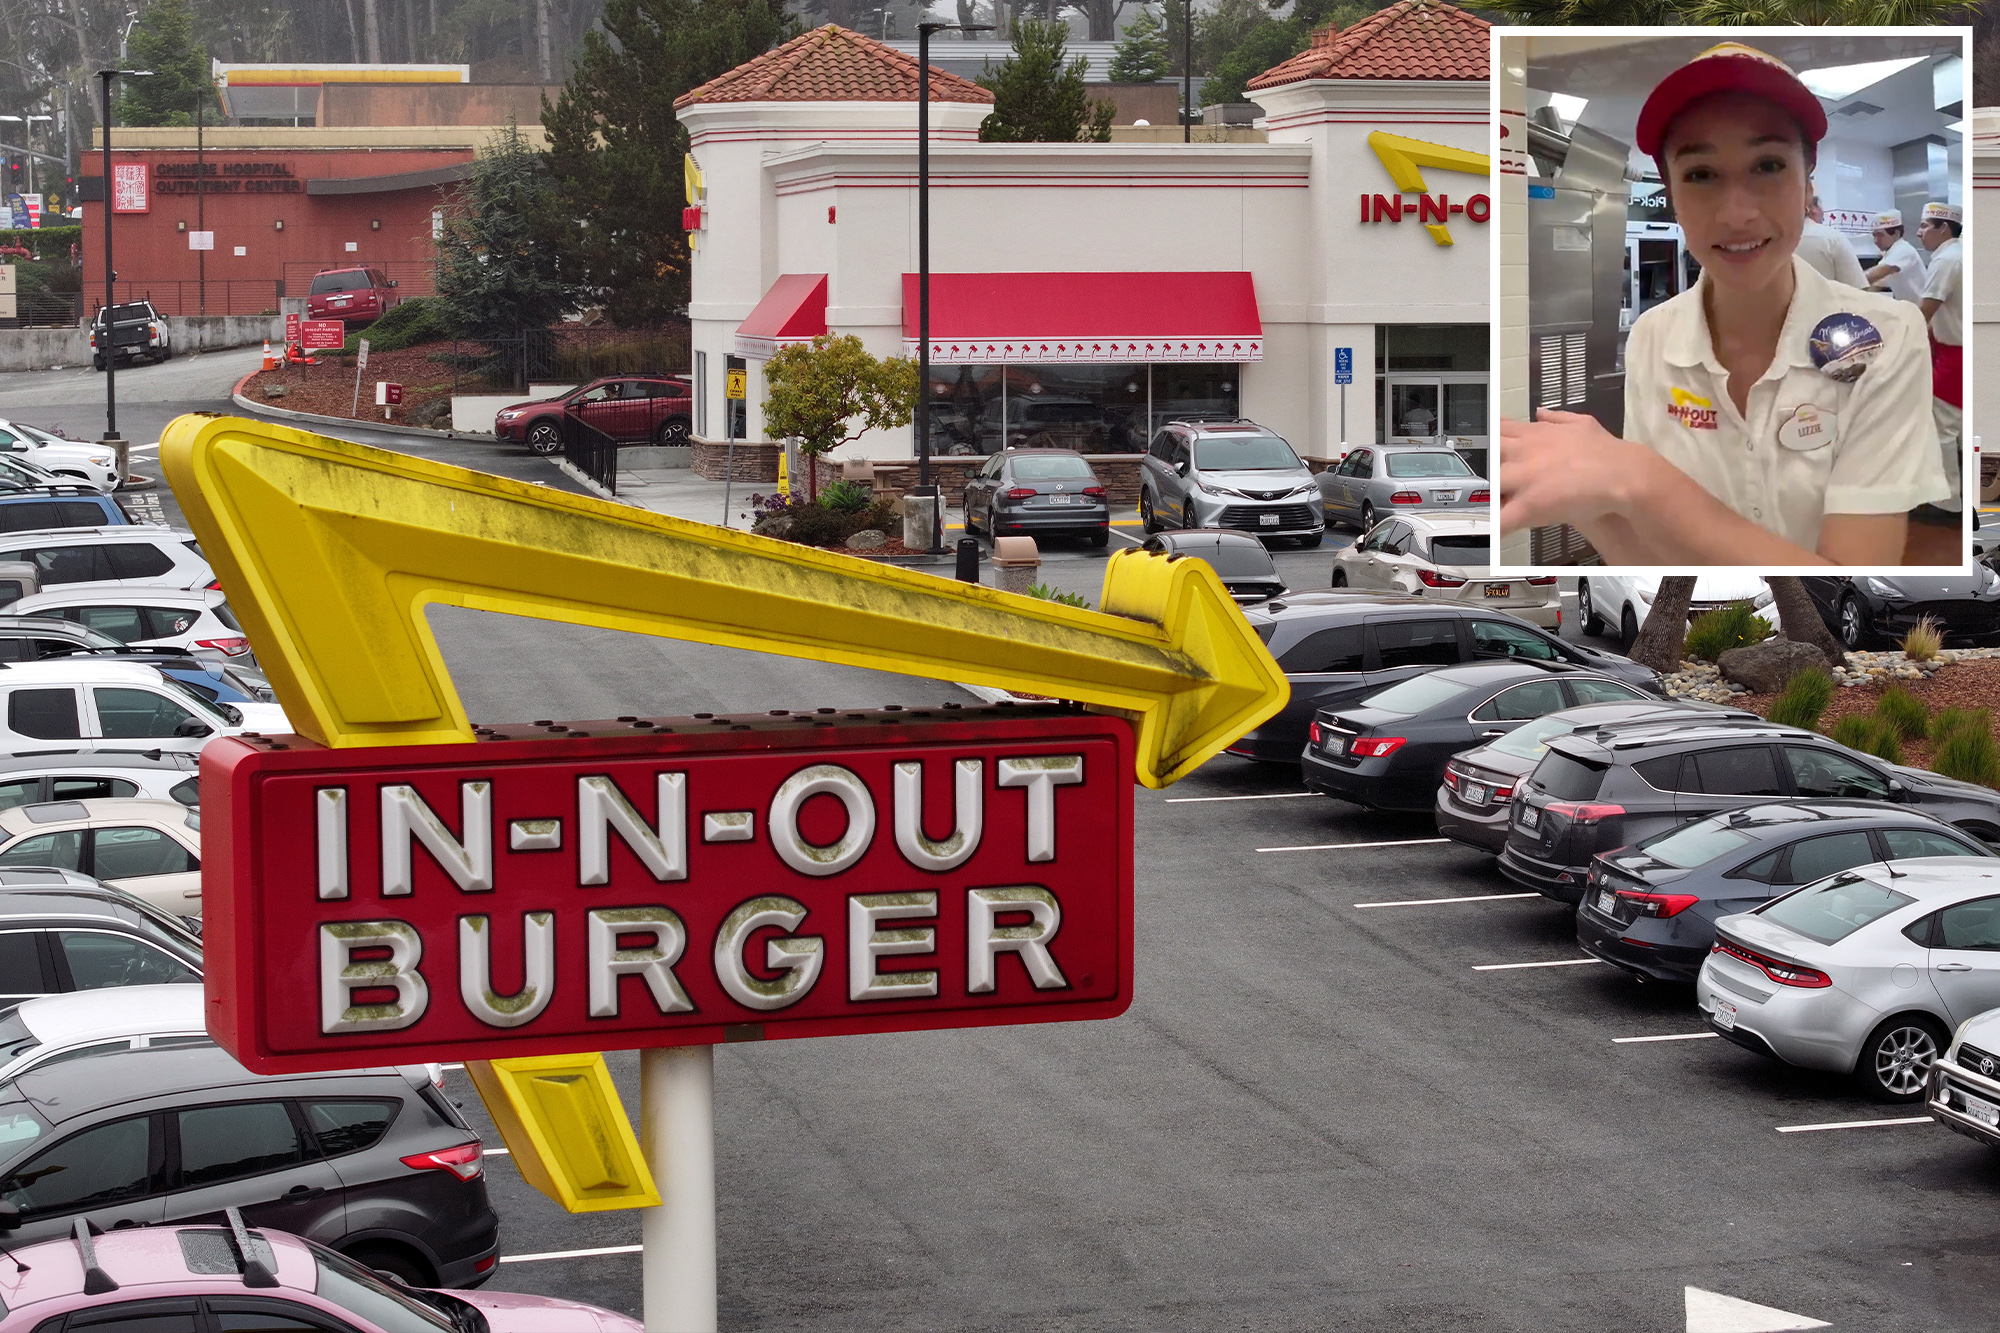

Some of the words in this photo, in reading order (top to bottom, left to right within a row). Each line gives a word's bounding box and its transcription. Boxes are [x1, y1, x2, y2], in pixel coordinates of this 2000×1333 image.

[156, 162, 217, 175] CHINESE
[223, 162, 291, 175] HOSPITAL
[156, 179, 241, 192] OUTPATIENT
[244, 179, 301, 193] CENTER
[1667, 404, 1718, 422] IN-N-OUT
[1798, 424, 1823, 438] LIZZIE
[316, 754, 1084, 901] IN-N-OUT
[320, 887, 1069, 1034] BURGER
